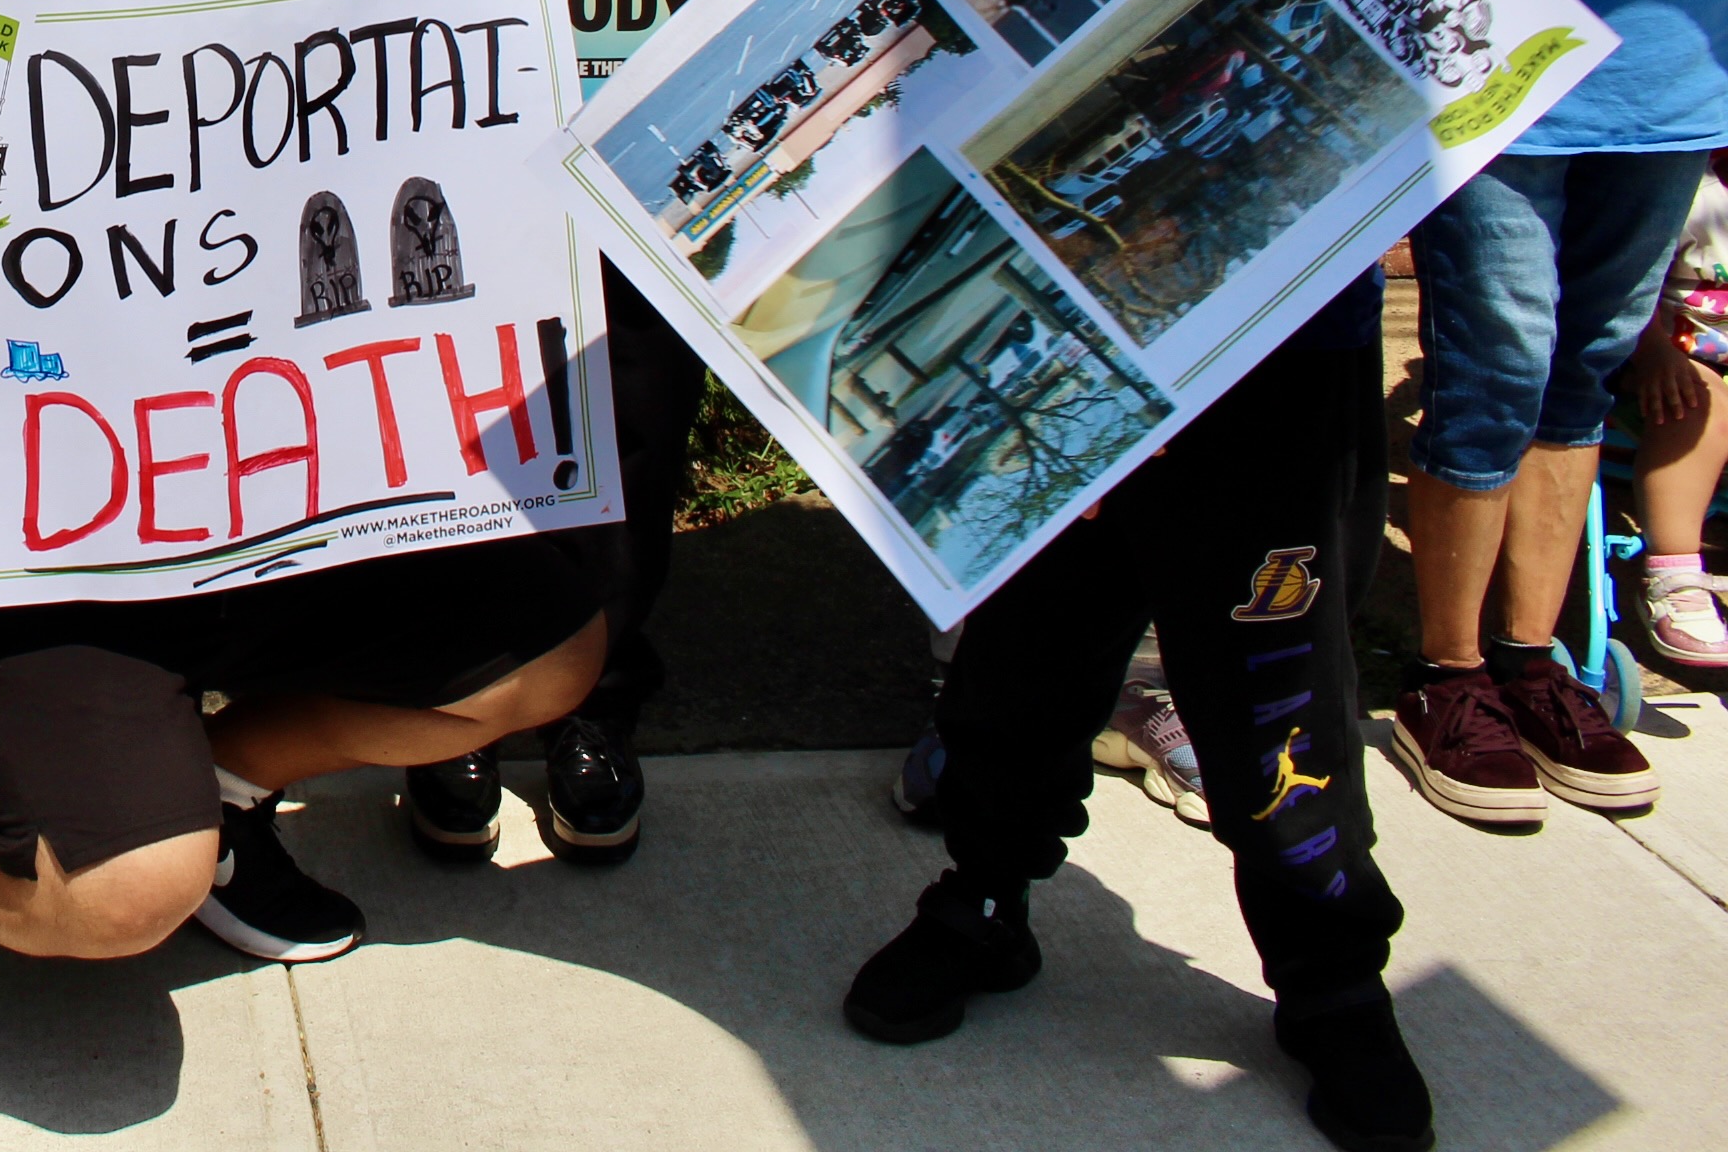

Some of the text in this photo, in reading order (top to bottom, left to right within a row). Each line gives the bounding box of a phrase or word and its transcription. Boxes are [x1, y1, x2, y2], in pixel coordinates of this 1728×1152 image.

[2, 209, 259, 309] ONS
[340, 494, 556, 539] WWW.MAKETHEROADNY.ORG
[383, 516, 514, 549] @MaketheRoadNY
